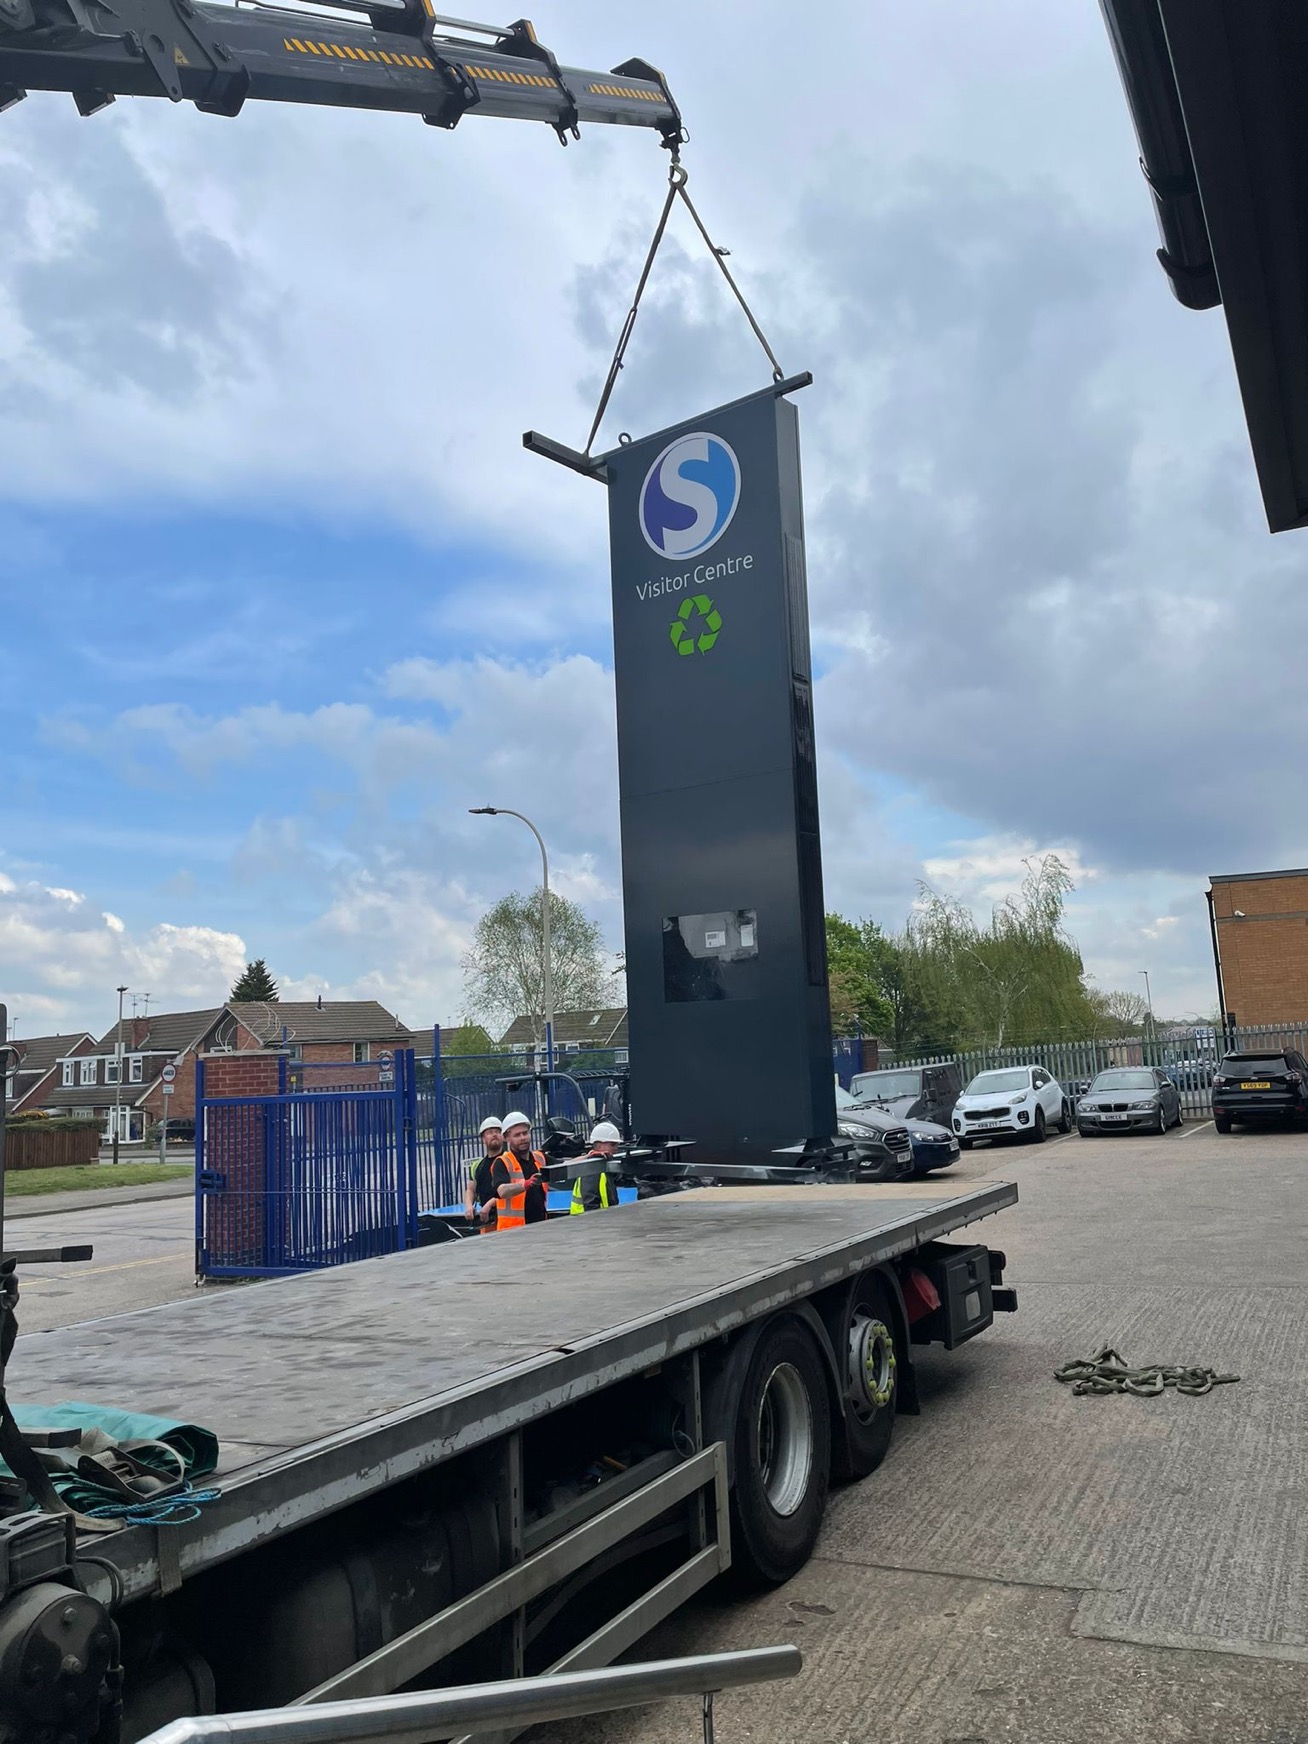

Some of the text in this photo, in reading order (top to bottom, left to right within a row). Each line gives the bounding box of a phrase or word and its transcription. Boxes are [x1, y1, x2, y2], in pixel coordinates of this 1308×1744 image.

[658, 437, 719, 554] S
[636, 554, 753, 601] Visitor Centre
